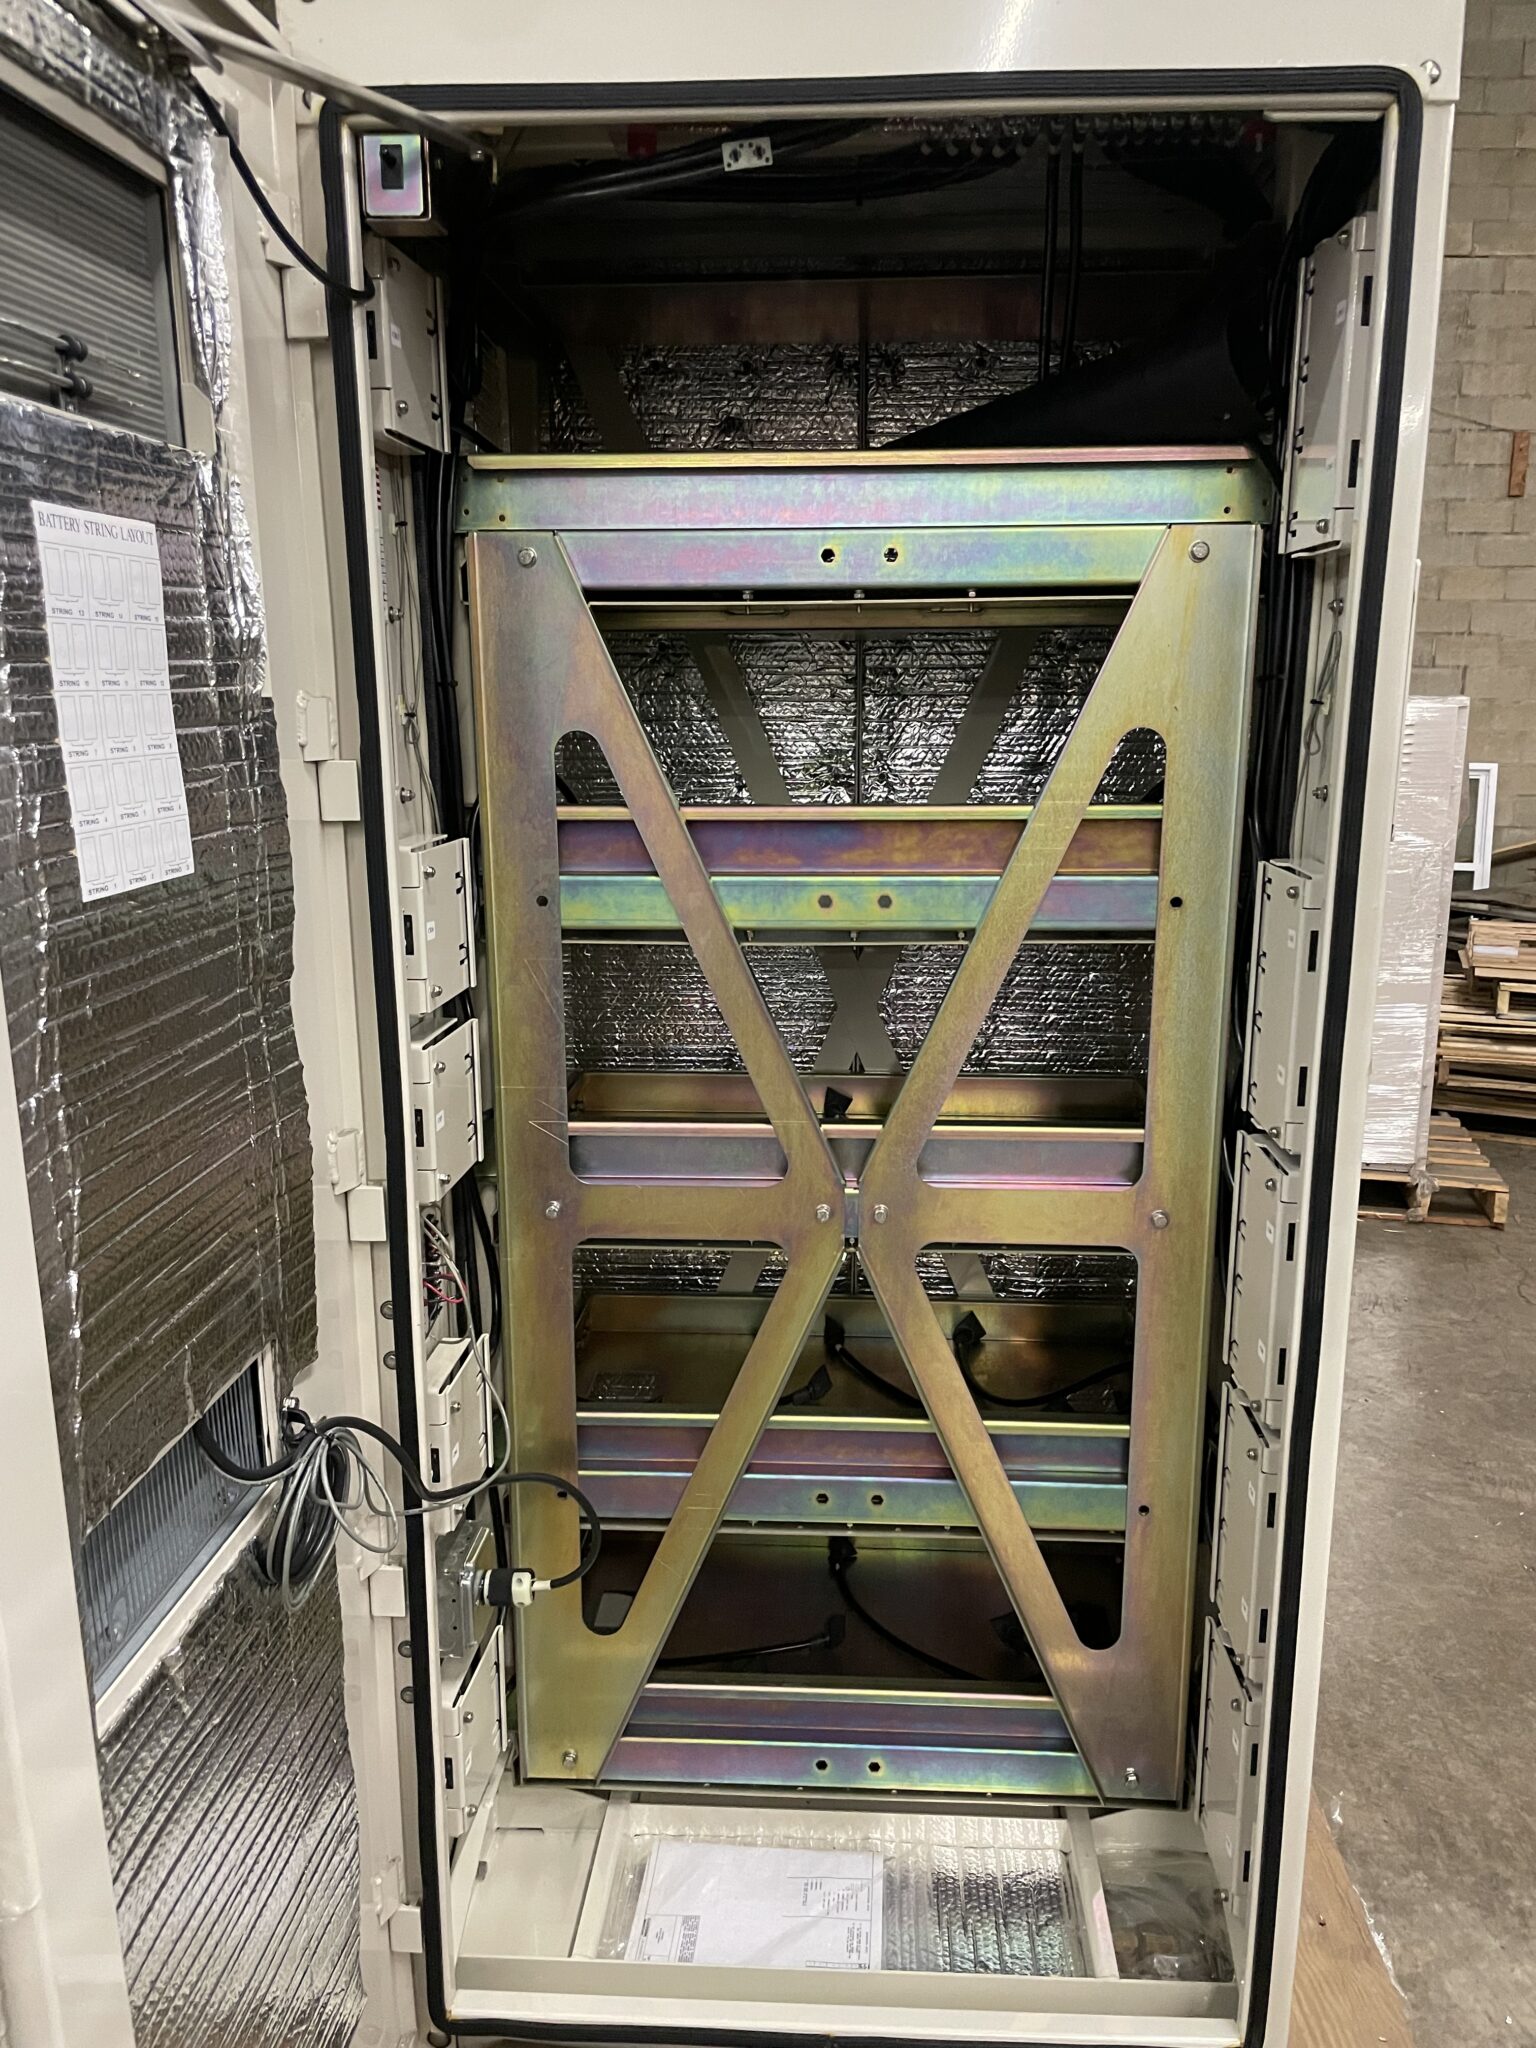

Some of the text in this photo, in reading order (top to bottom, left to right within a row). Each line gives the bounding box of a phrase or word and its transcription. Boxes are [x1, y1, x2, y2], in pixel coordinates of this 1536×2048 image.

[38, 511, 154, 546] BATTERY STRING LAYOUT
[52, 608, 73, 616] STRING
[120, 811, 139, 820] STRING
[79, 818, 100, 827] STRING
[164, 867, 183, 875] STRING
[129, 876, 147, 885] STRING
[88, 886, 109, 896] STRING
